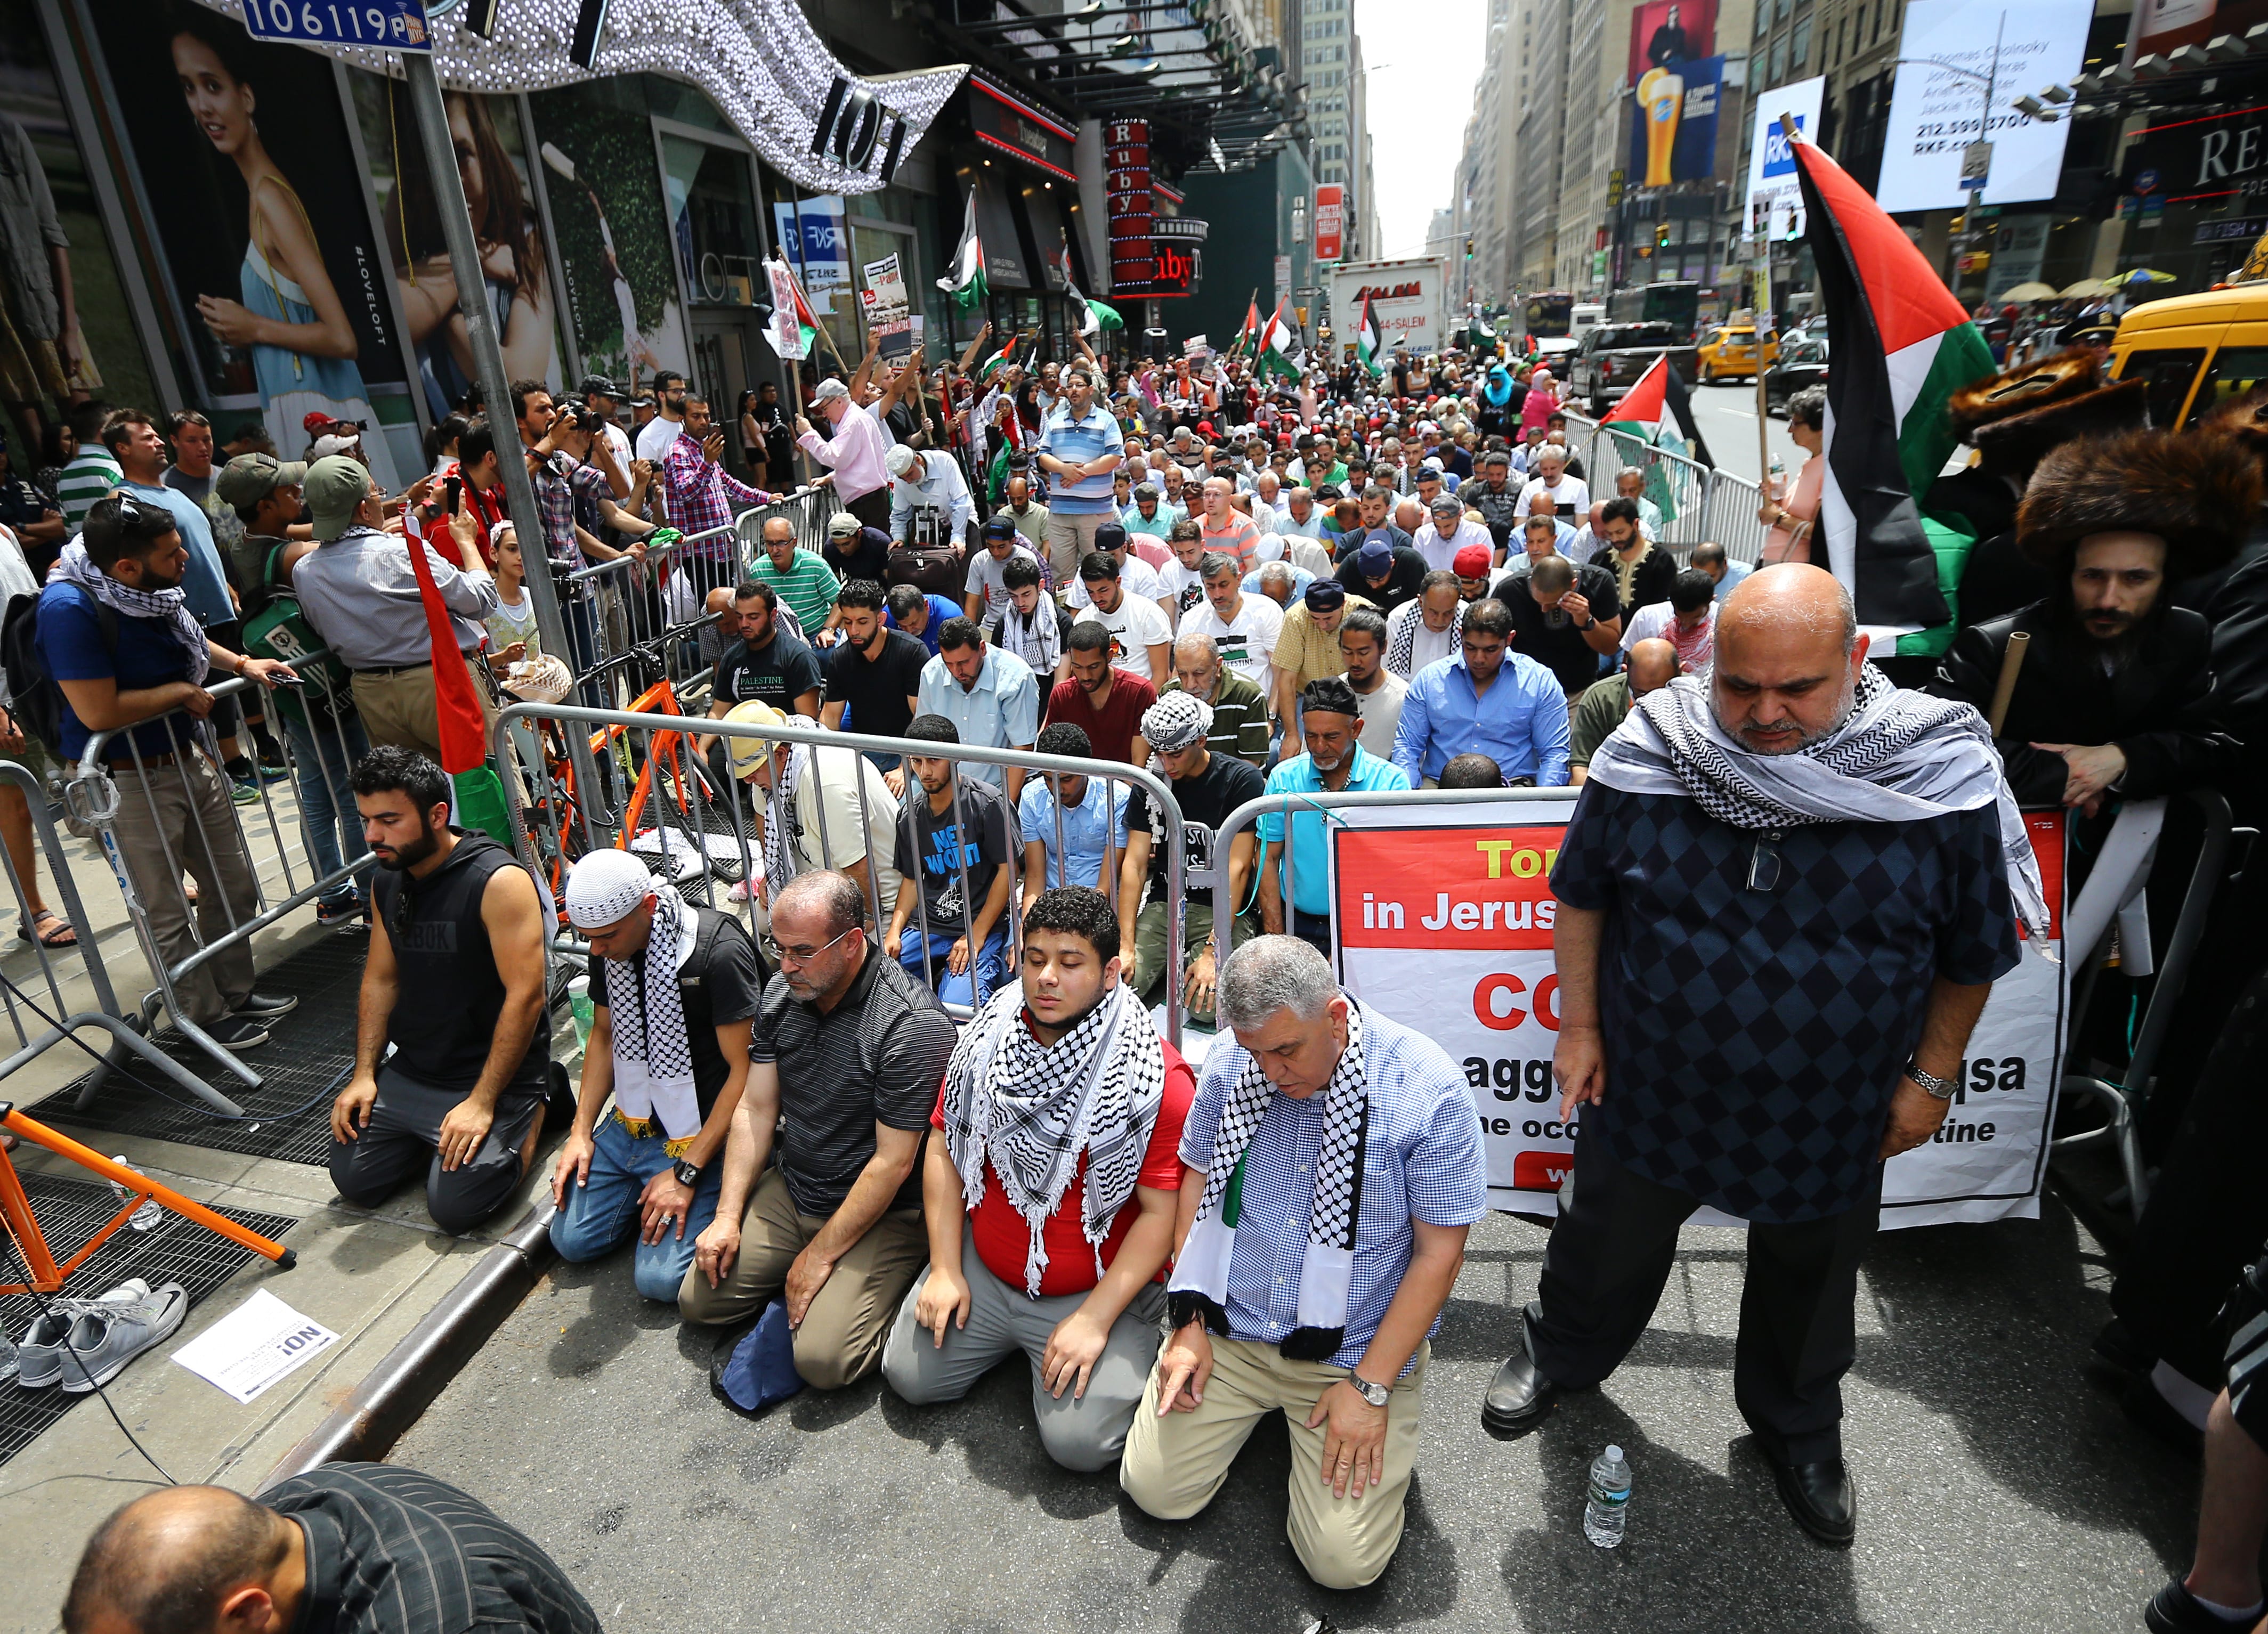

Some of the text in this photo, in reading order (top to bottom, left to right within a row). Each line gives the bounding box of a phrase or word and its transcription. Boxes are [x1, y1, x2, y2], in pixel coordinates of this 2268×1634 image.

[248, 0, 386, 40] 106119
[409, 29, 425, 44] NYC
[1765, 133, 1795, 165] RK
[1913, 140, 1971, 157] RKF.co
[2193, 124, 2268, 187] RE
[355, 246, 386, 345] #LOVELOFT
[740, 676, 784, 685] PALESTINE
[1363, 892, 1558, 931] in Jerus
[276, 1325, 321, 1356] NO!
